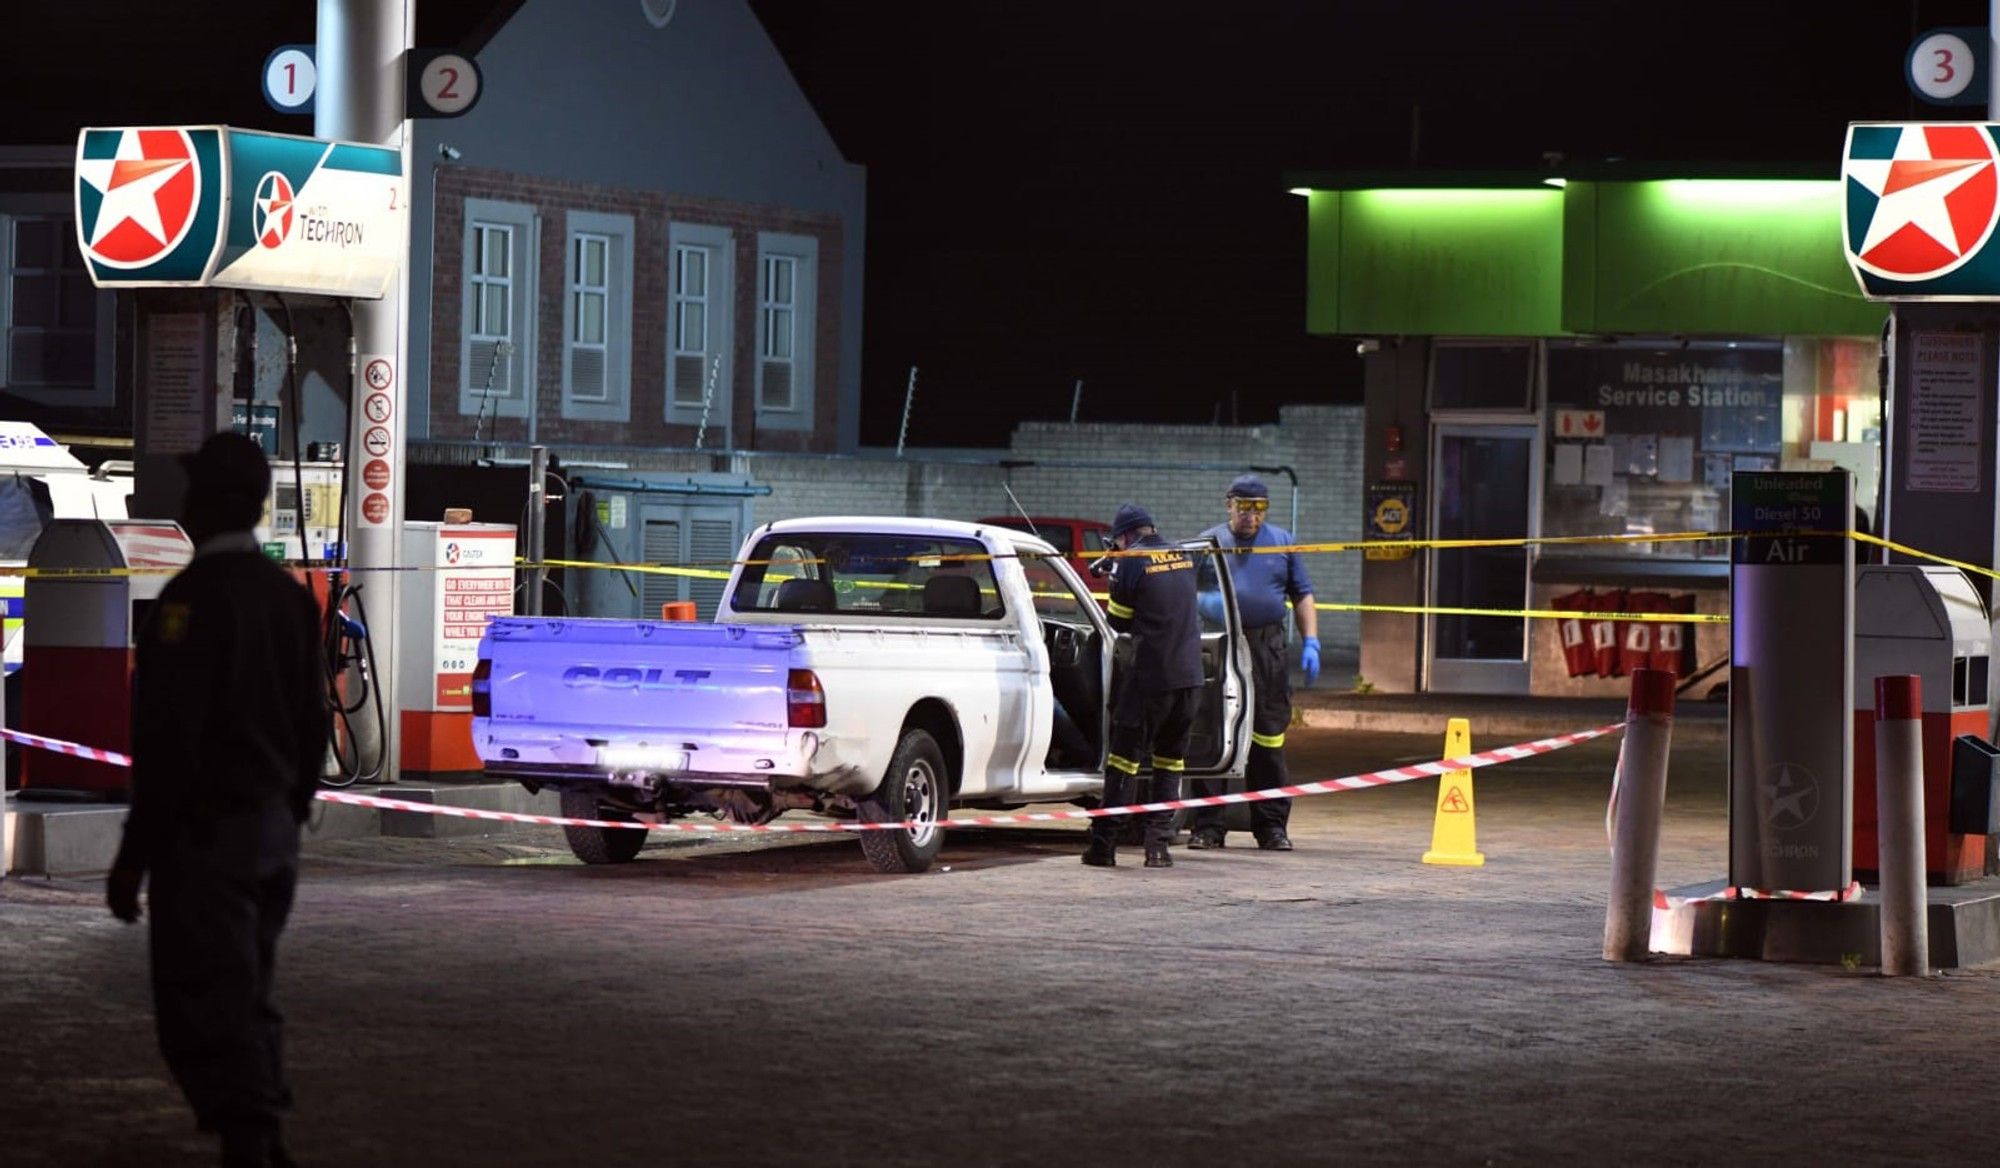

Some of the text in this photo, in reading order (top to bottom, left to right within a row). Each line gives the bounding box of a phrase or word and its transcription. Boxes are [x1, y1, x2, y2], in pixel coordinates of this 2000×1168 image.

[1933, 49, 1955, 83] 3
[283, 62, 296, 95] 1
[437, 67, 459, 99] 2
[389, 187, 397, 211] 2
[300, 214, 364, 249] TECHRON
[1599, 384, 1767, 407] Service Station
[1754, 477, 1823, 490] Unleaded
[1754, 505, 1796, 520] Diesel
[1765, 538, 1811, 561] Air
[563, 666, 712, 691] COLT
